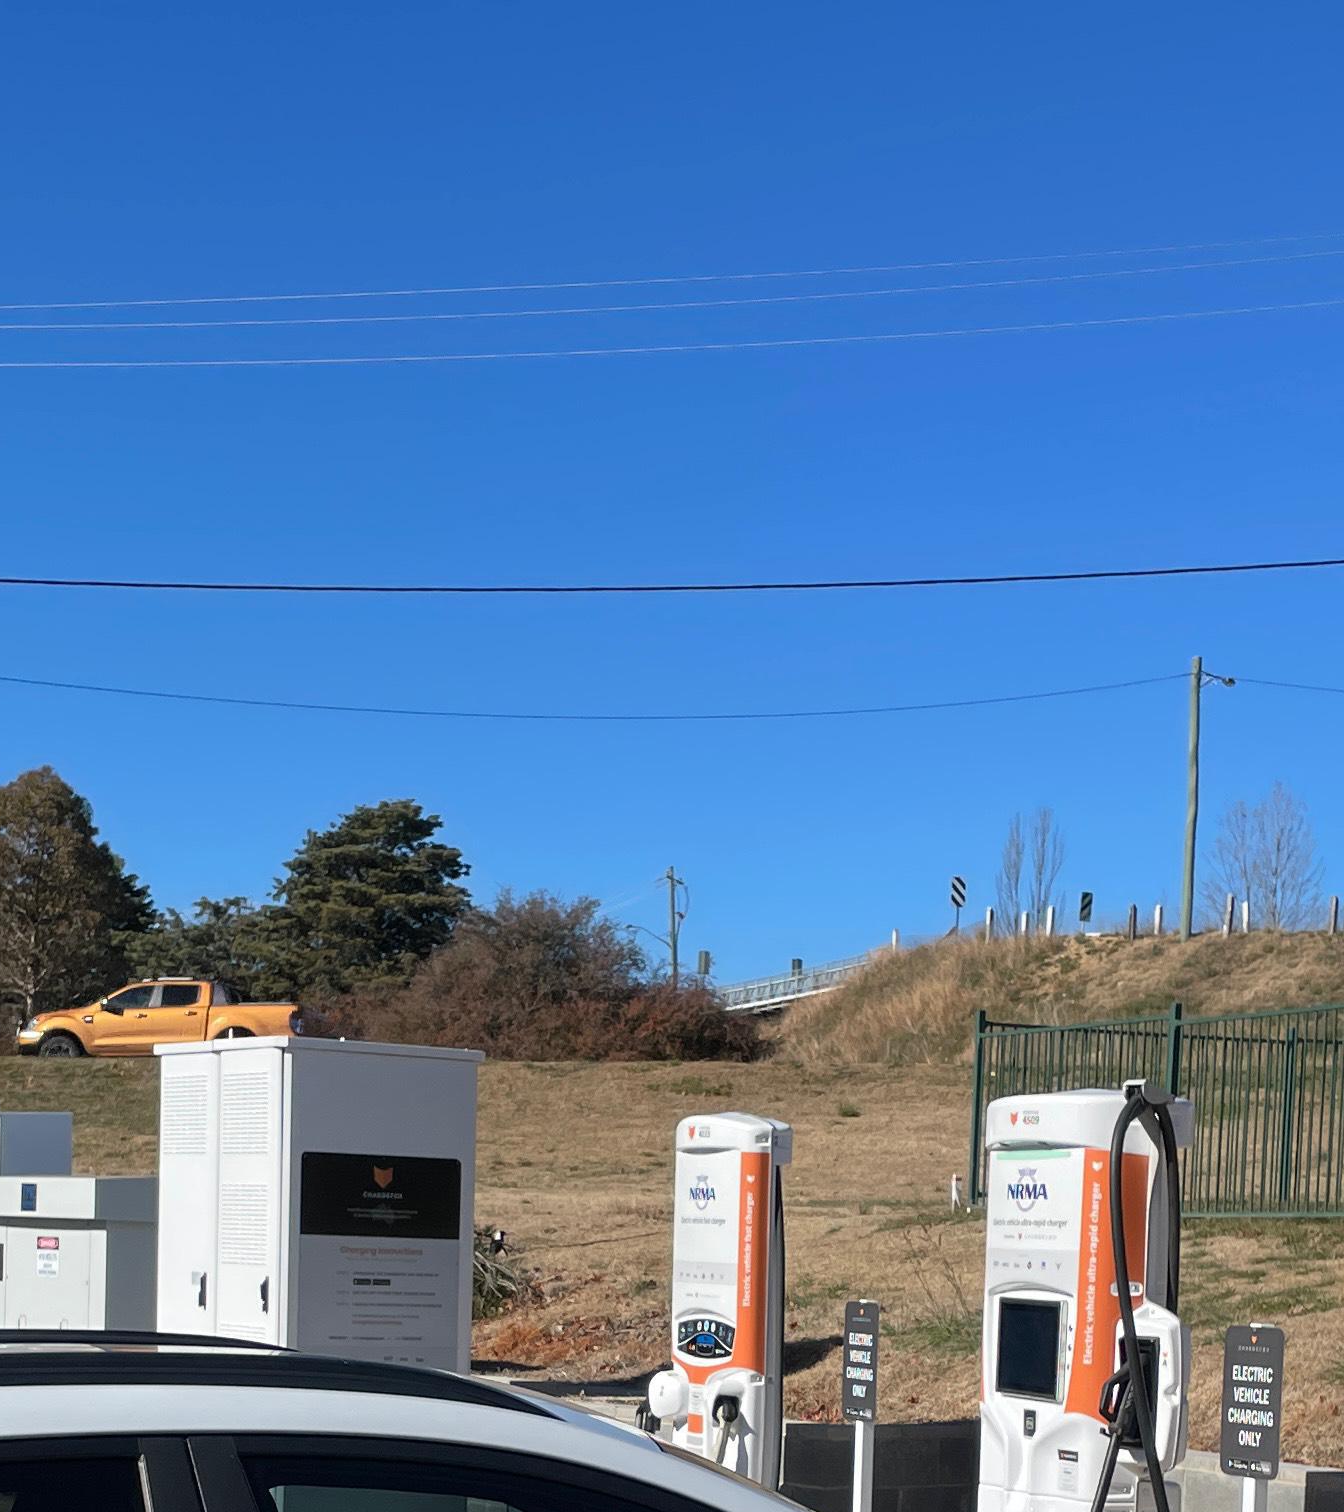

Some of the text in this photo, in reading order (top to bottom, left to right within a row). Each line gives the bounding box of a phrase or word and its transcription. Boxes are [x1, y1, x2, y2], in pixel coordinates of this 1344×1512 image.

[689, 1187, 716, 1201] NRMA
[1007, 1183, 1048, 1200] NRMA
[1082, 1182, 1103, 1365] Electric vehicle ultra-rapid charger
[1232, 1365, 1273, 1383] ELECTRIC
[1233, 1387, 1270, 1405] VEHICLE
[1227, 1407, 1274, 1427] CHARGING
[1238, 1430, 1262, 1447] ONLY
